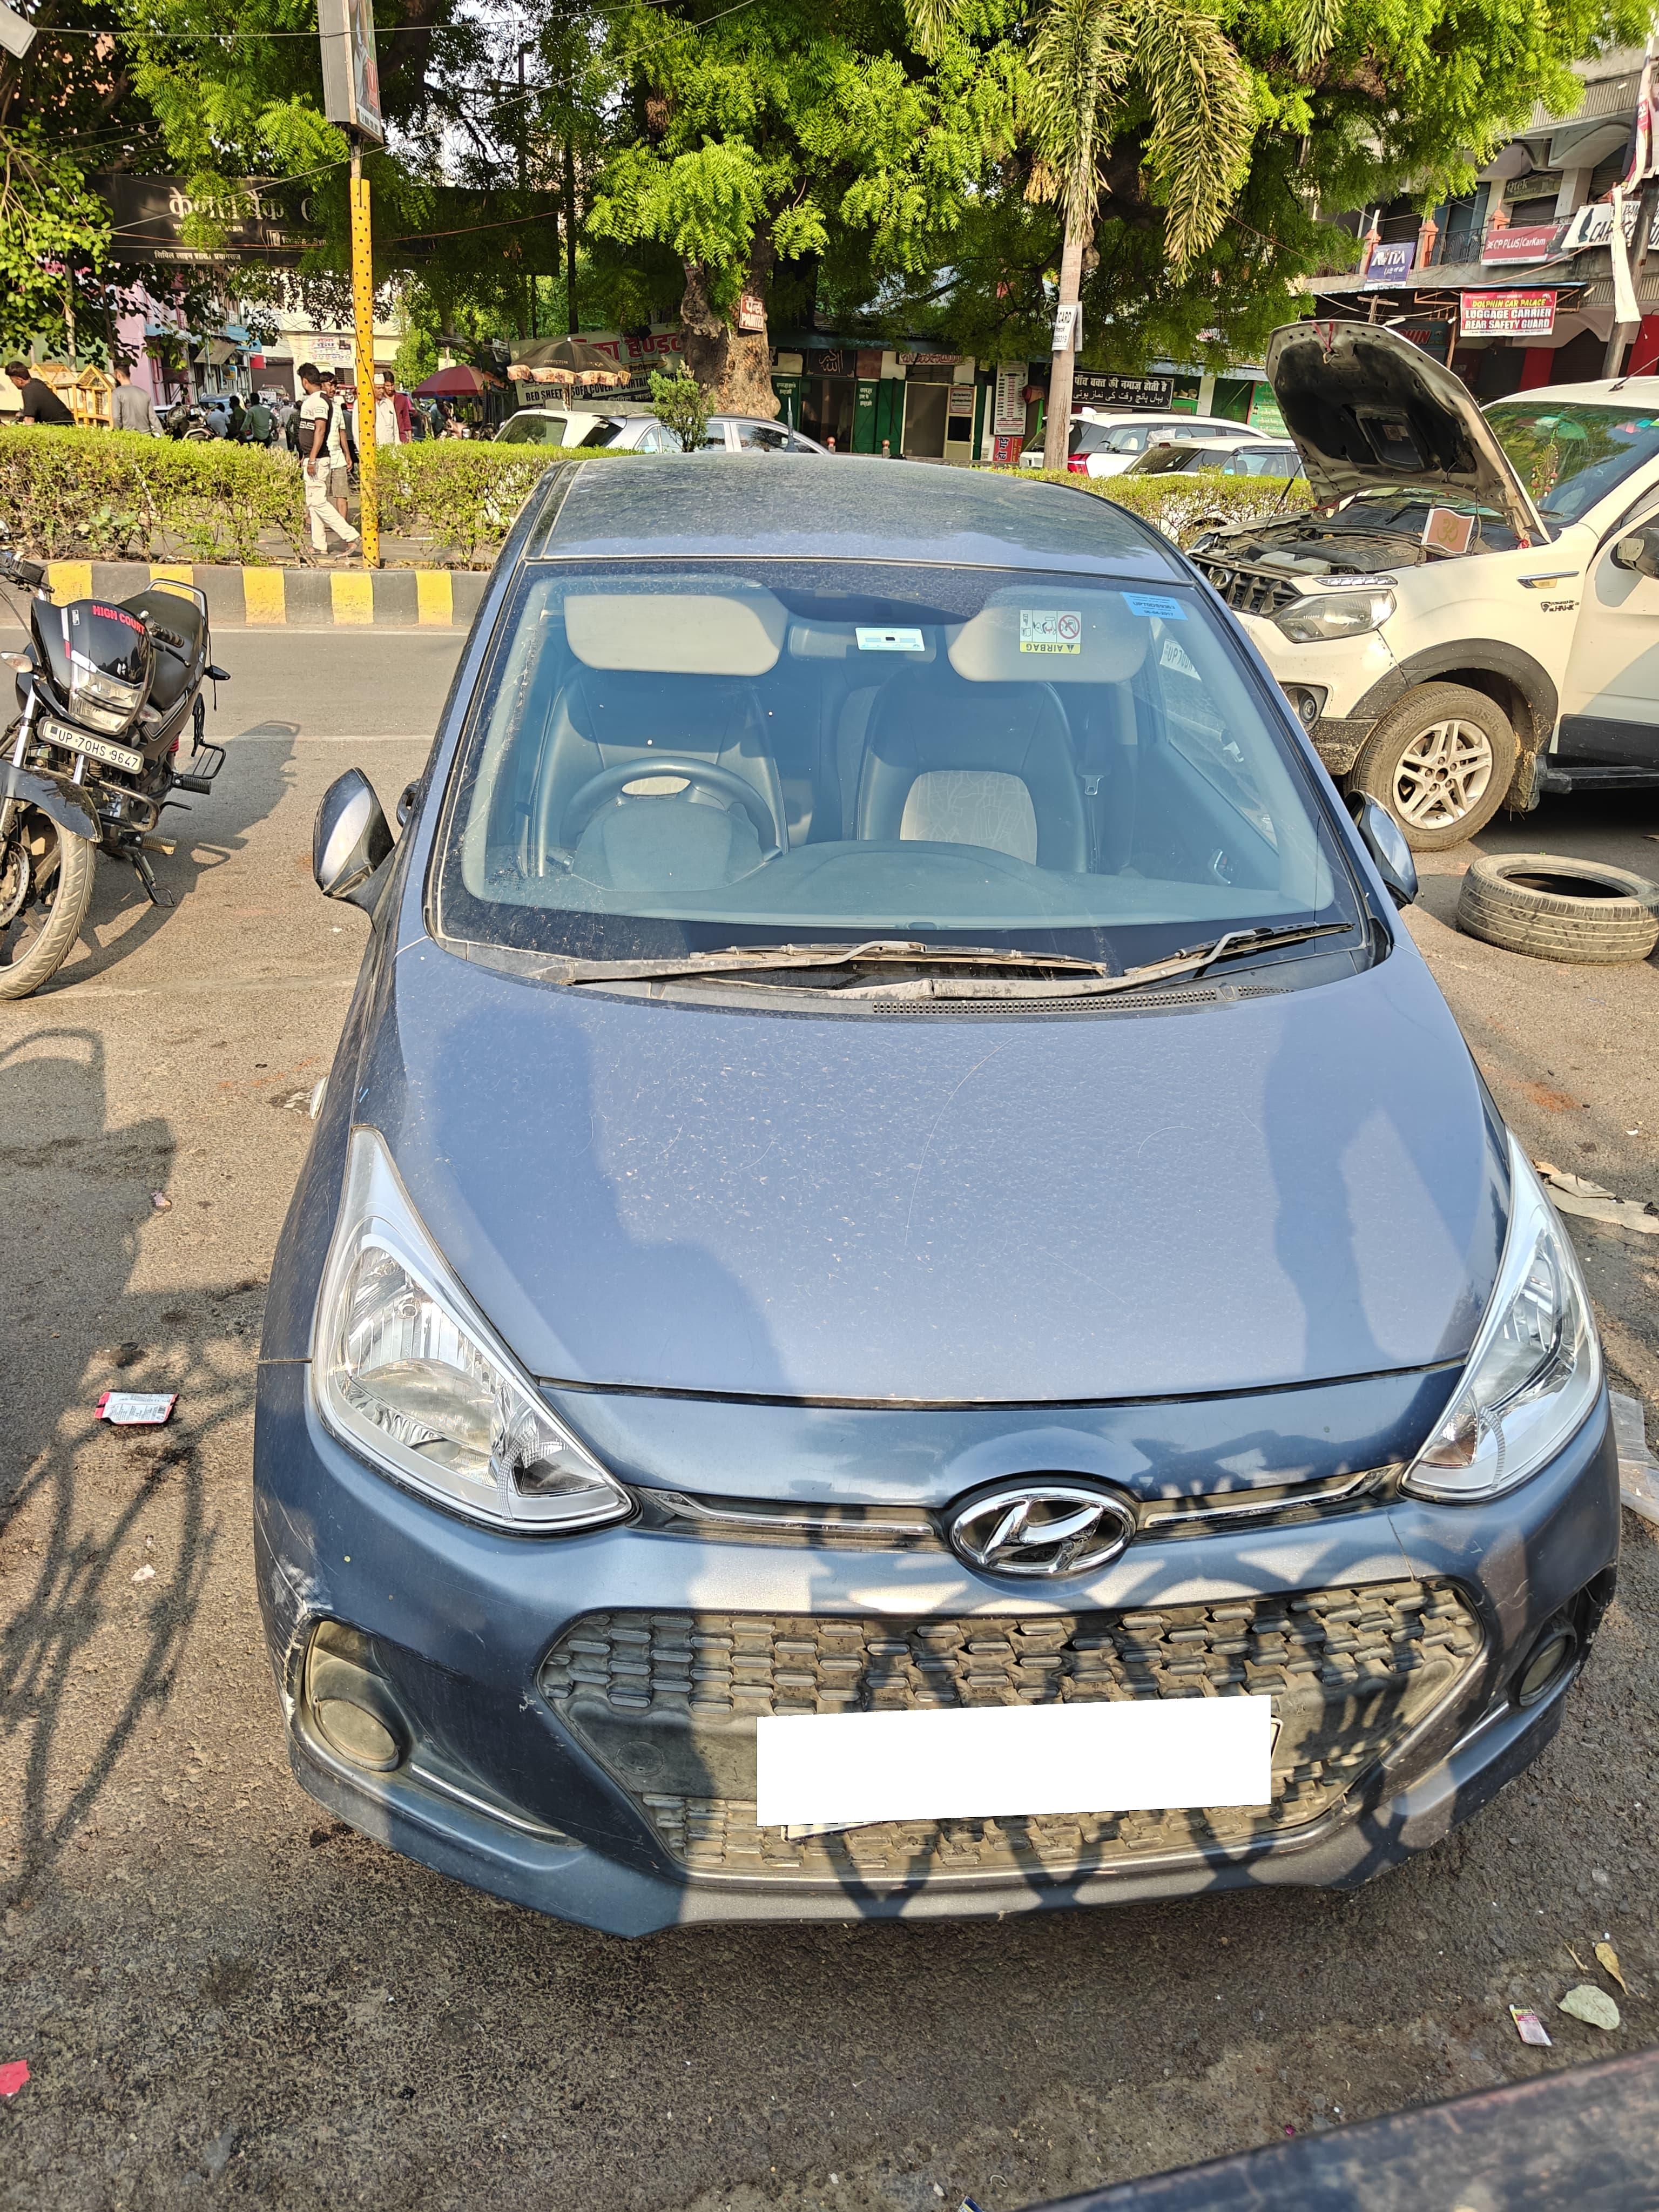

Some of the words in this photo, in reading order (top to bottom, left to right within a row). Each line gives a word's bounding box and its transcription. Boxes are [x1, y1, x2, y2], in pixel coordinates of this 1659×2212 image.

[1472, 299, 1504, 308] DOLPHIN
[1504, 299, 1519, 307] CAR
[1520, 298, 1547, 307] PALACE
[1058, 312, 1071, 323] CARD
[1465, 309, 1509, 319] LUGGAGE
[1510, 308, 1552, 318] CARRIER
[1465, 320, 1487, 329] REAR
[1488, 319, 1520, 329] SAFETY
[1521, 318, 1550, 328] GUARD
[1143, 379, 1161, 392] होती
[1161, 381, 1168, 393] है
[525, 391, 539, 402] BED
[571, 385, 588, 395] SOFA
[589, 382, 613, 393] COVER
[92, 605, 118, 620] HIGH
[118, 613, 145, 635] COURT
[1025, 644, 1062, 652] AIRBAG
[58, 730, 72, 744] UP
[77, 738, 107, 757] 70HS
[110, 750, 138, 768] 9647
